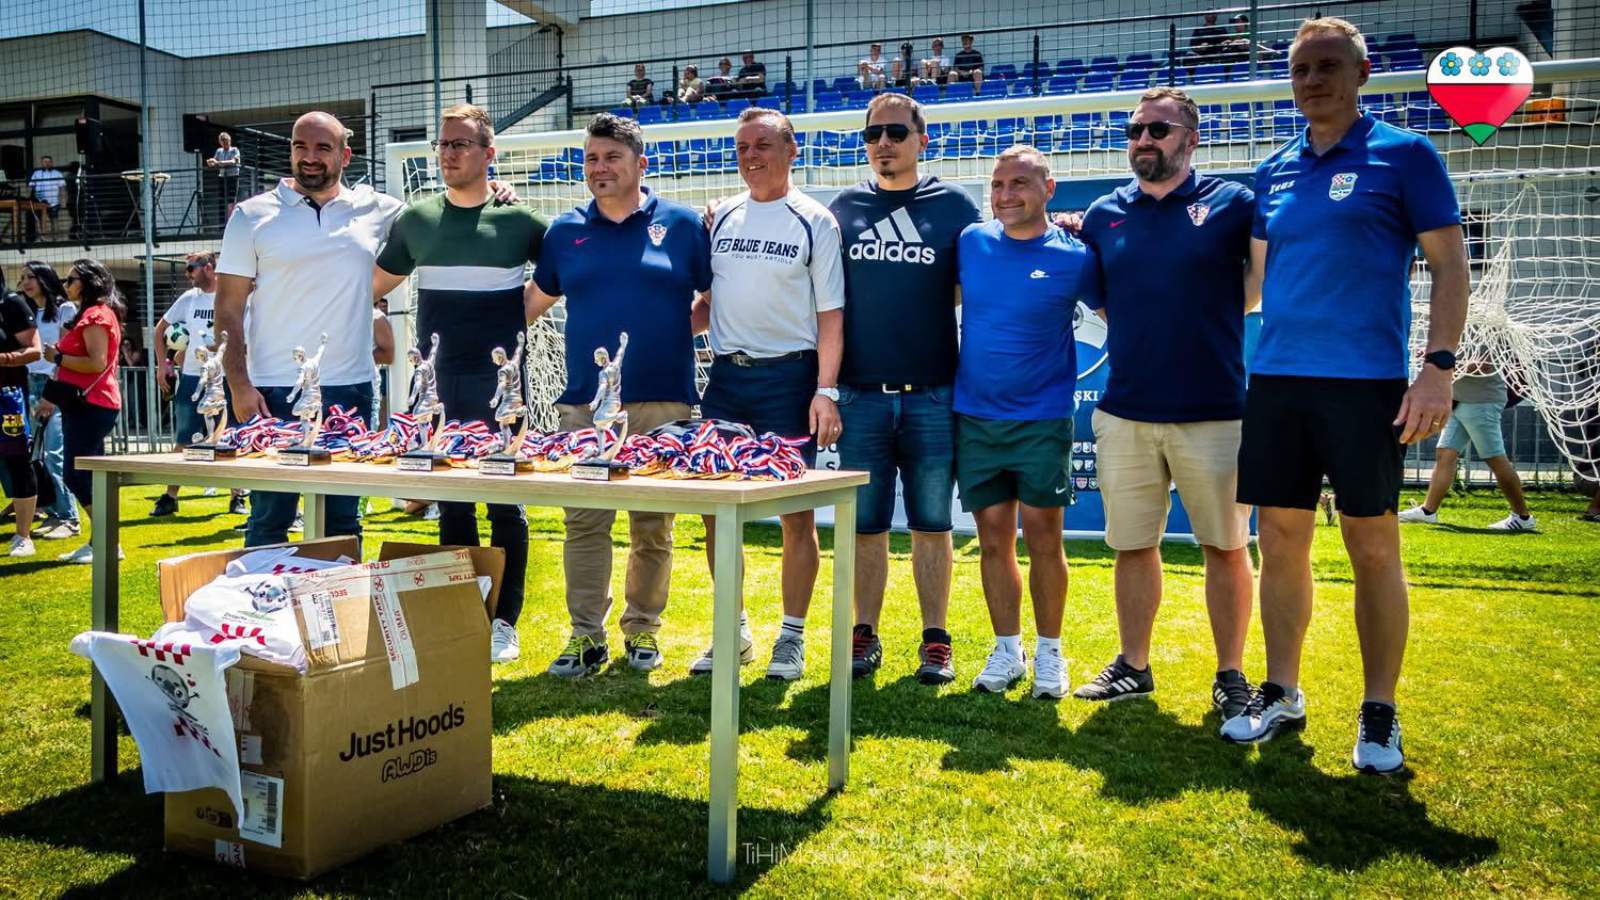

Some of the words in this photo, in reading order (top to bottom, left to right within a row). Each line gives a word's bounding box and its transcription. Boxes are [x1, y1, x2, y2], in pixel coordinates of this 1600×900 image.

[733, 238, 760, 253] BLUE
[762, 239, 799, 259] JEANS
[849, 239, 936, 264] adidas
[194, 309, 214, 319] PUM
[381, 618, 397, 662] SECURITY
[339, 723, 396, 762] Just
[398, 703, 465, 746] Hoods
